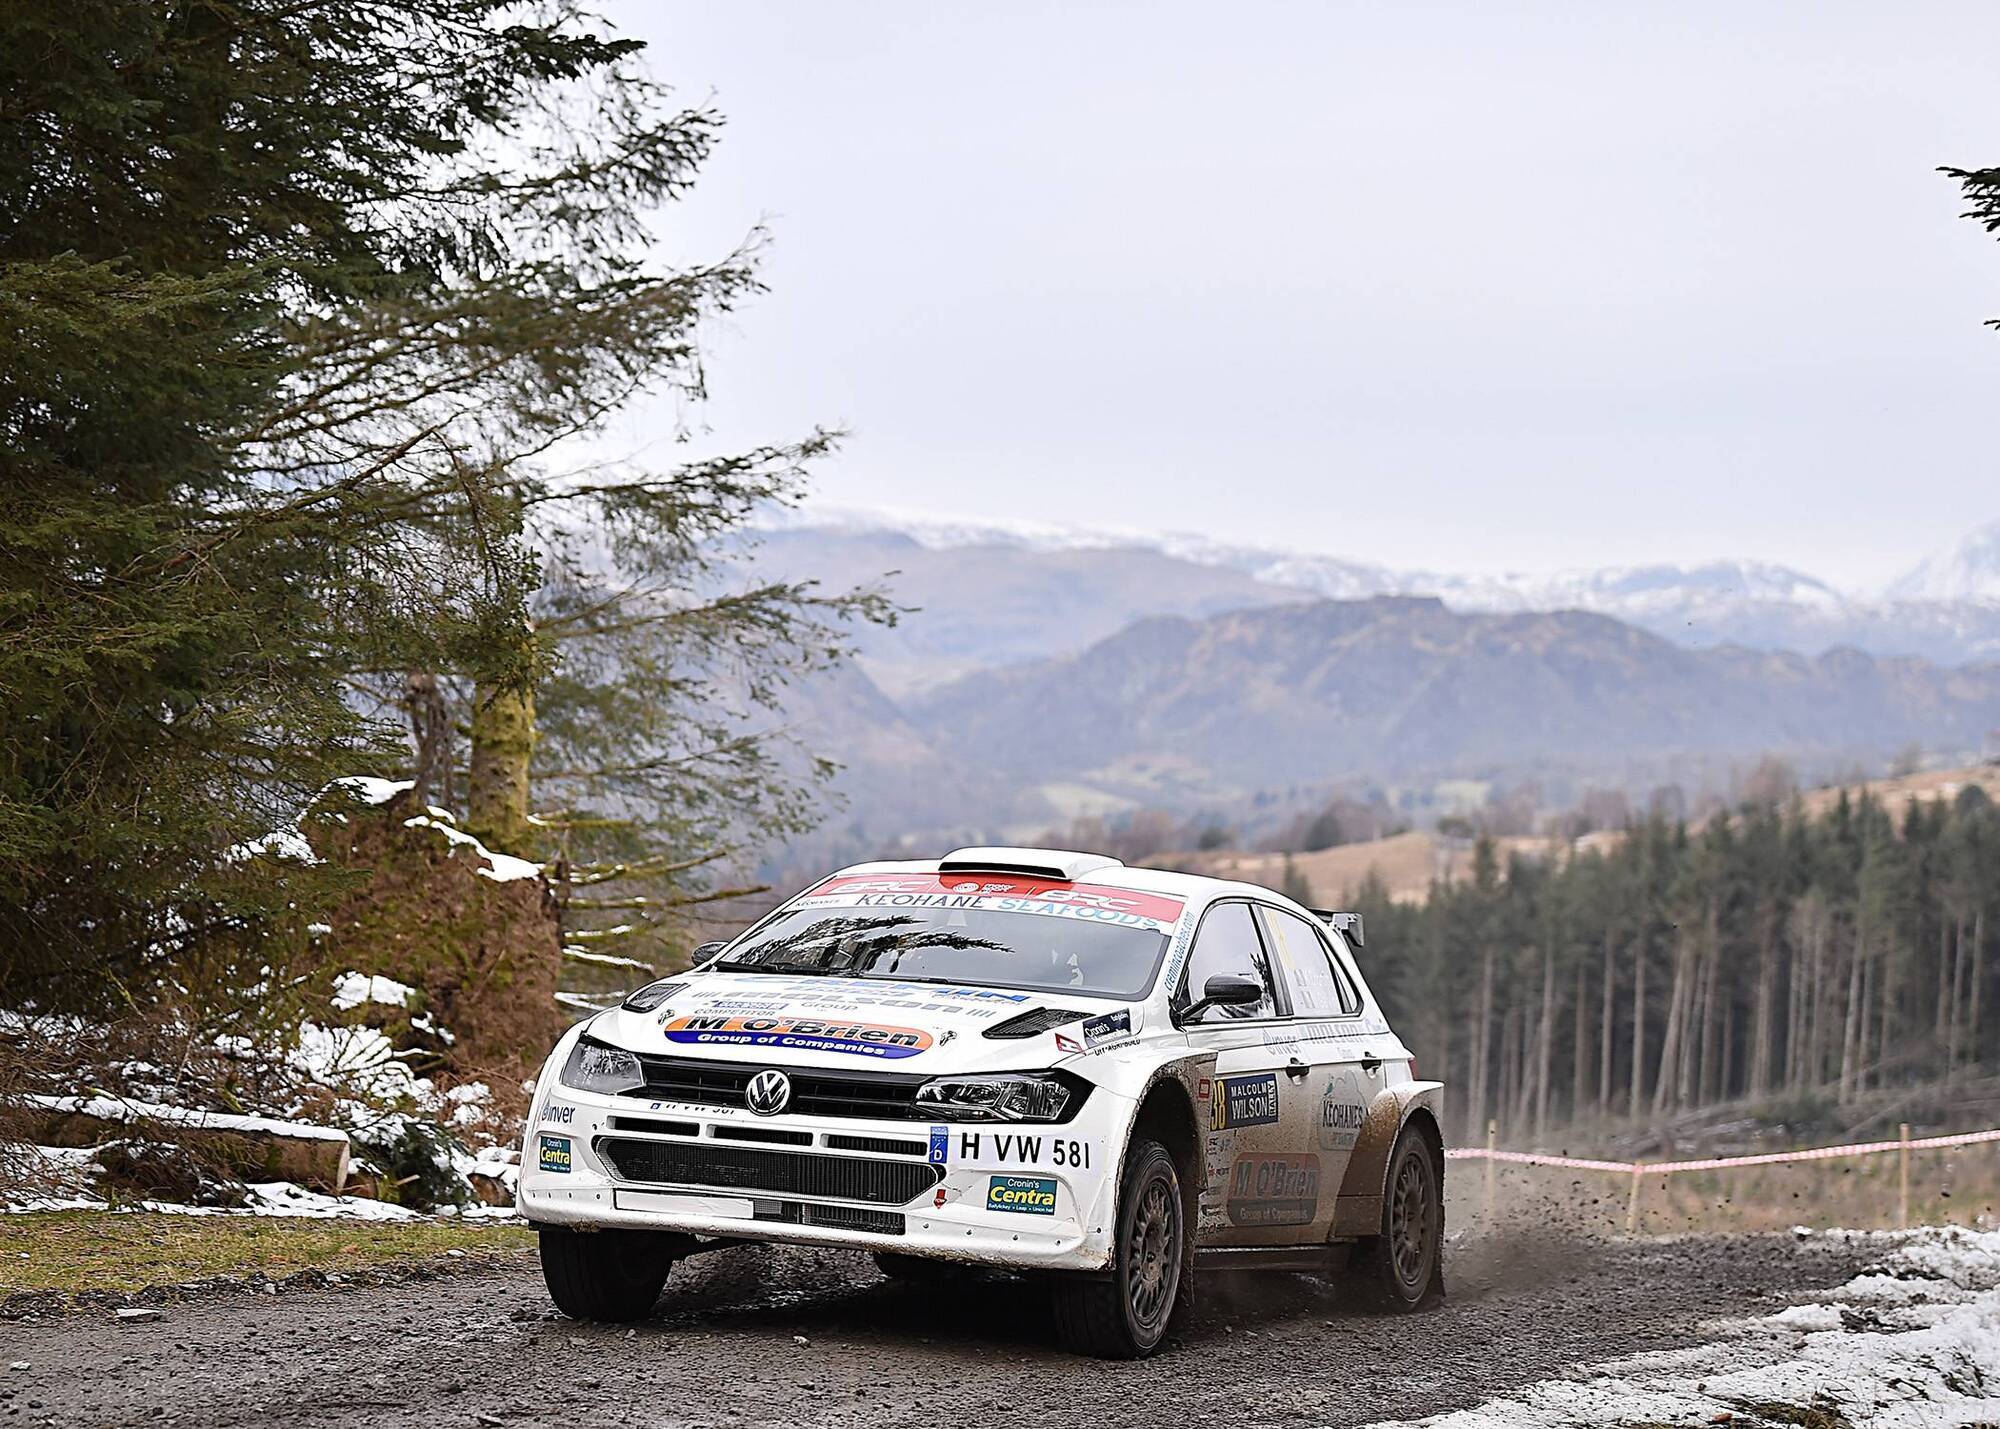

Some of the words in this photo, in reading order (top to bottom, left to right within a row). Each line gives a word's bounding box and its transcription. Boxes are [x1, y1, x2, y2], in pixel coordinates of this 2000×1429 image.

[855, 894, 991, 908] KEOHANE
[998, 898, 1158, 927] SEAFOODS
[1037, 890, 1142, 911] BRC
[1164, 911, 1195, 992] cremincoaches.com
[694, 1009, 776, 1017] COMPETITOR
[685, 1016, 727, 1030] M
[742, 1017, 922, 1048] O'Brien
[697, 1034, 752, 1045] Group
[757, 1035, 775, 1044] of
[782, 1037, 887, 1056] Companies
[1230, 1082, 1268, 1097] MALCOLM
[1211, 1080, 1226, 1131] 38
[1231, 1096, 1268, 1119] WILSON
[541, 1146, 570, 1165] Centra
[933, 1149, 943, 1161] D
[961, 1132, 980, 1159] H
[994, 1134, 1042, 1163] VW
[1053, 1139, 1090, 1169] 581
[1007, 1178, 1040, 1189] Cronin's
[990, 1185, 1055, 1206] Centra
